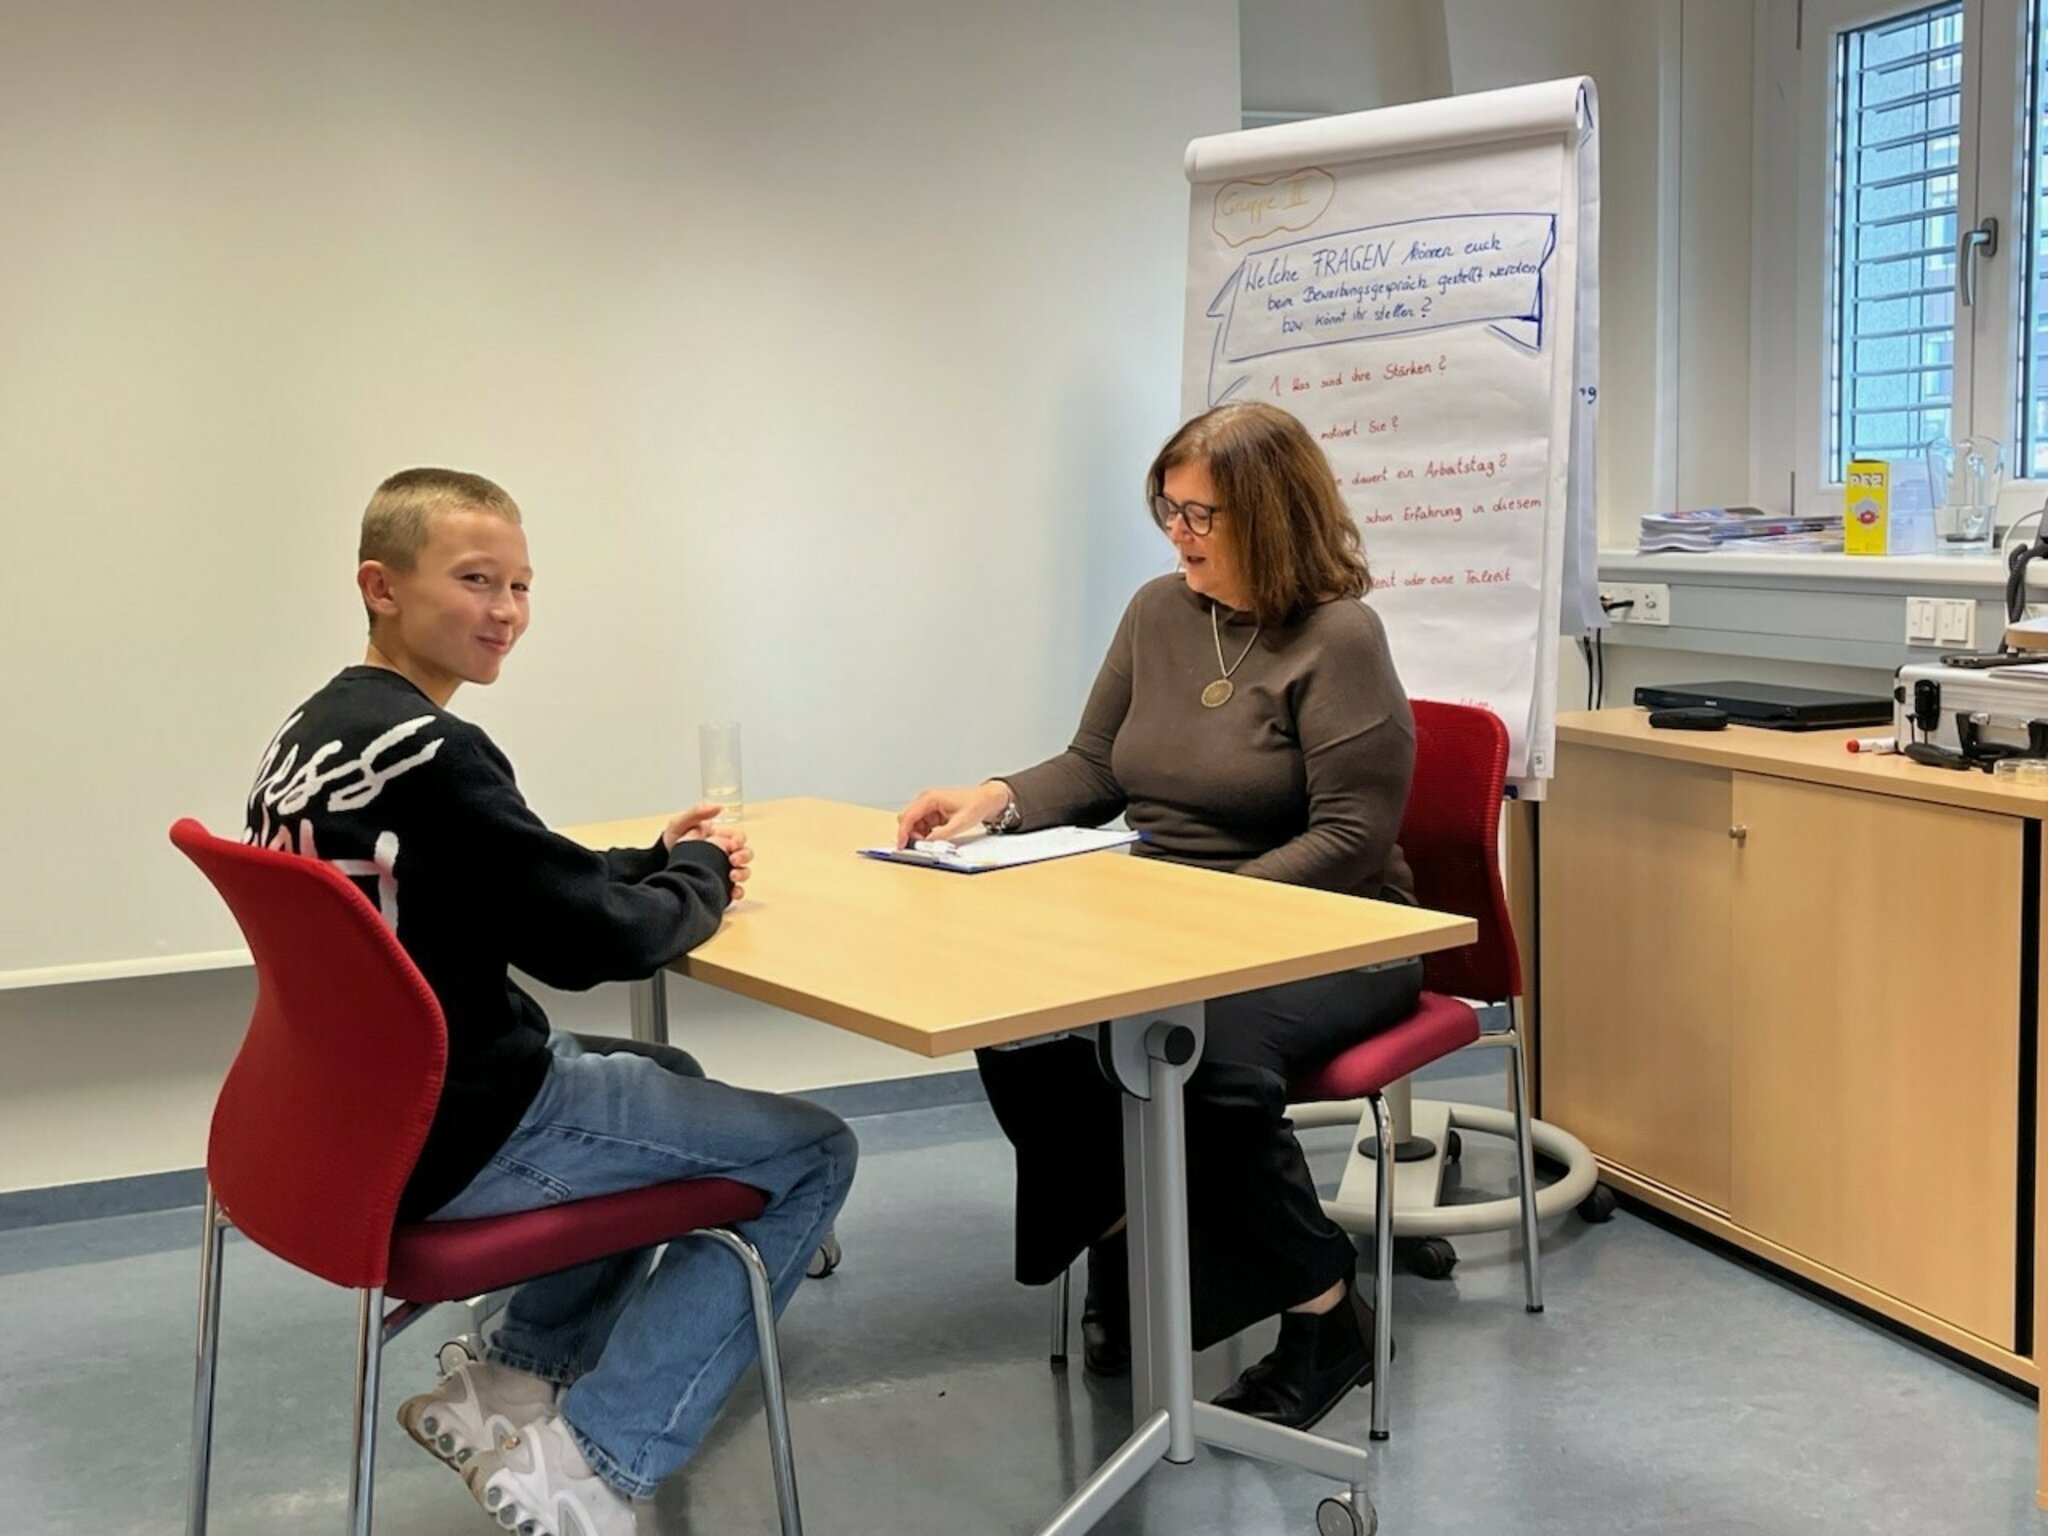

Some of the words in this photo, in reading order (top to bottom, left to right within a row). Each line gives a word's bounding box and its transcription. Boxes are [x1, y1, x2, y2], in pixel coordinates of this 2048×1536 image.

[1244, 254, 1300, 292] Welche
[1312, 240, 1395, 278] FRAGEN
[1401, 240, 1454, 265] können
[1464, 232, 1502, 255] euch
[1303, 274, 1427, 303] Bewerbungsgespräch
[1438, 266, 1482, 295] gestellt
[1489, 261, 1537, 279] werden
[1352, 307, 1366, 321] ihr
[1320, 372, 1343, 388] sind
[1351, 466, 1387, 486] dauert
[1365, 508, 1393, 524] schon
[1403, 505, 1462, 522] Erfahrung
[1472, 504, 1485, 514] in
[1492, 497, 1542, 513] diesem
[1404, 572, 1426, 586] oder
[1430, 575, 1454, 585] eine
